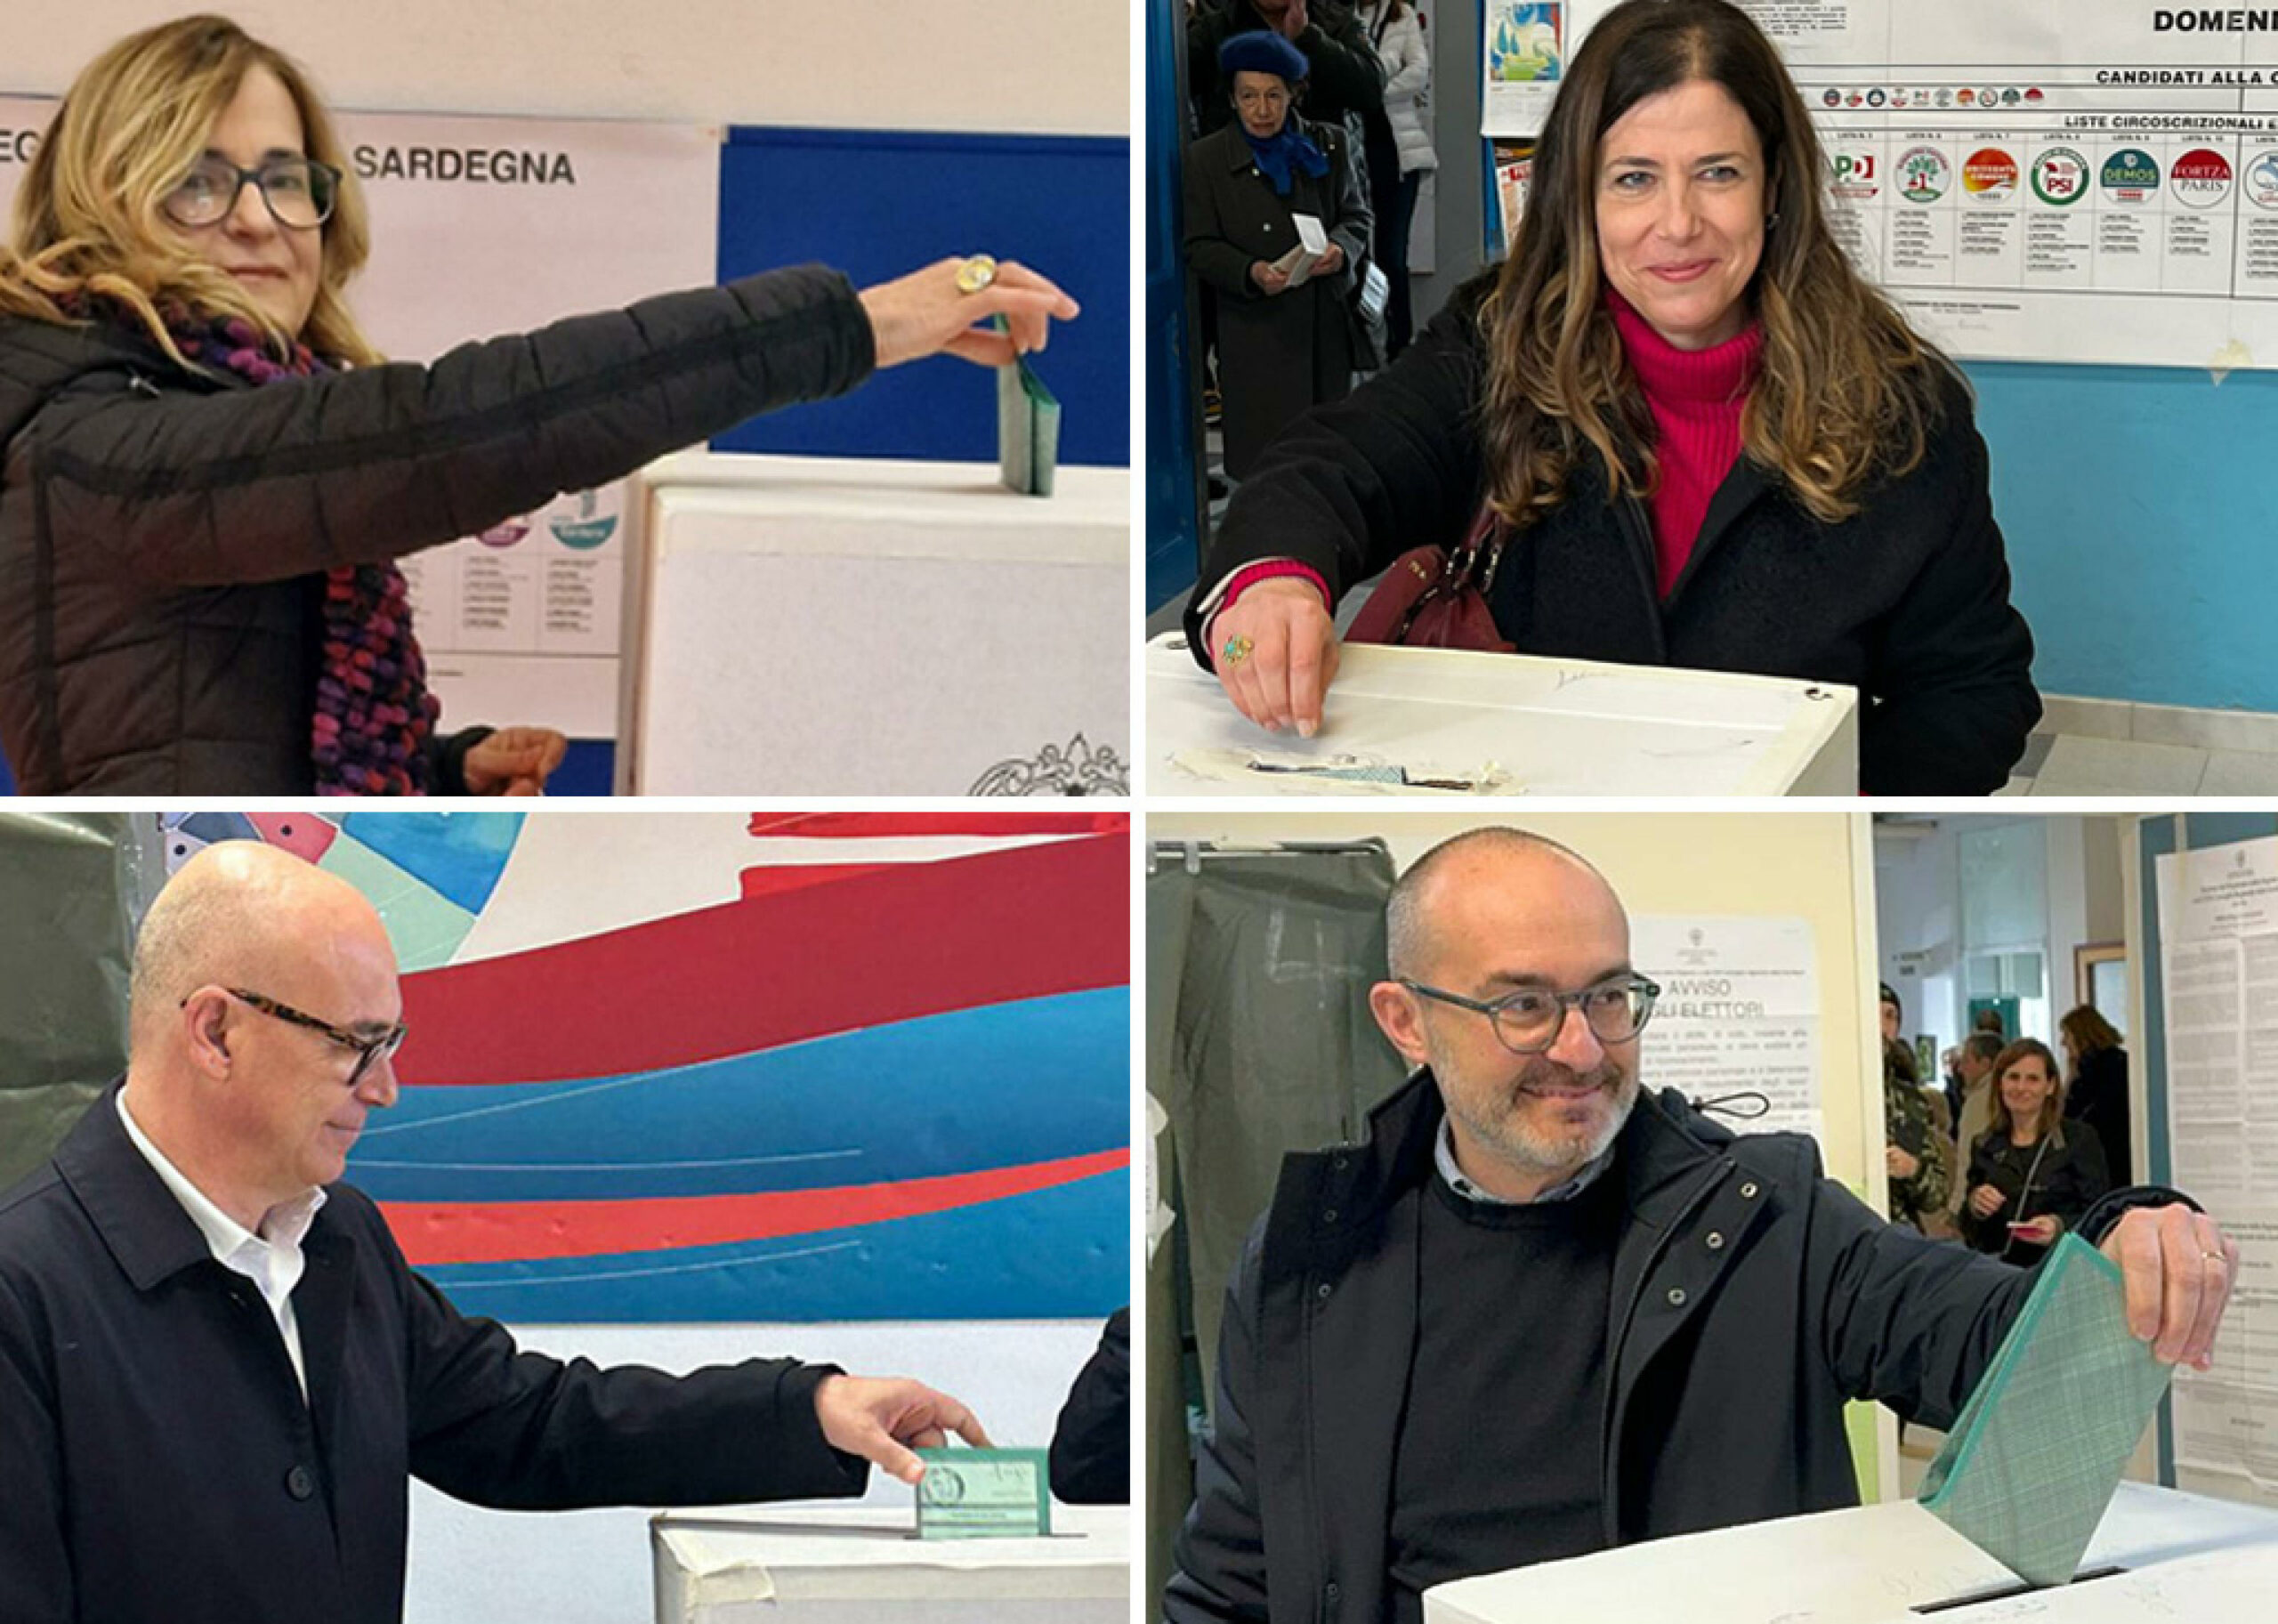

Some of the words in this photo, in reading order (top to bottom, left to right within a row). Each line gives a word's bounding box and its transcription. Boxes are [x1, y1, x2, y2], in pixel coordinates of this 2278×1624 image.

[2096, 70, 2203, 84] CANDIDATI
[2211, 70, 2263, 84] ALLA
[2064, 115, 2107, 127] LISTE
[2112, 116, 2264, 130] CIRCOSCRIZIONALI
[353, 144, 577, 185] SARDEGNA
[2173, 165, 2231, 179] FORTZA
[2104, 168, 2157, 181] DEMOS
[2047, 177, 2073, 193] PSI
[2180, 178, 2224, 191] PARIS
[1668, 978, 1732, 997] AVVISO
[1680, 1000, 1765, 1020] ELETTORI
